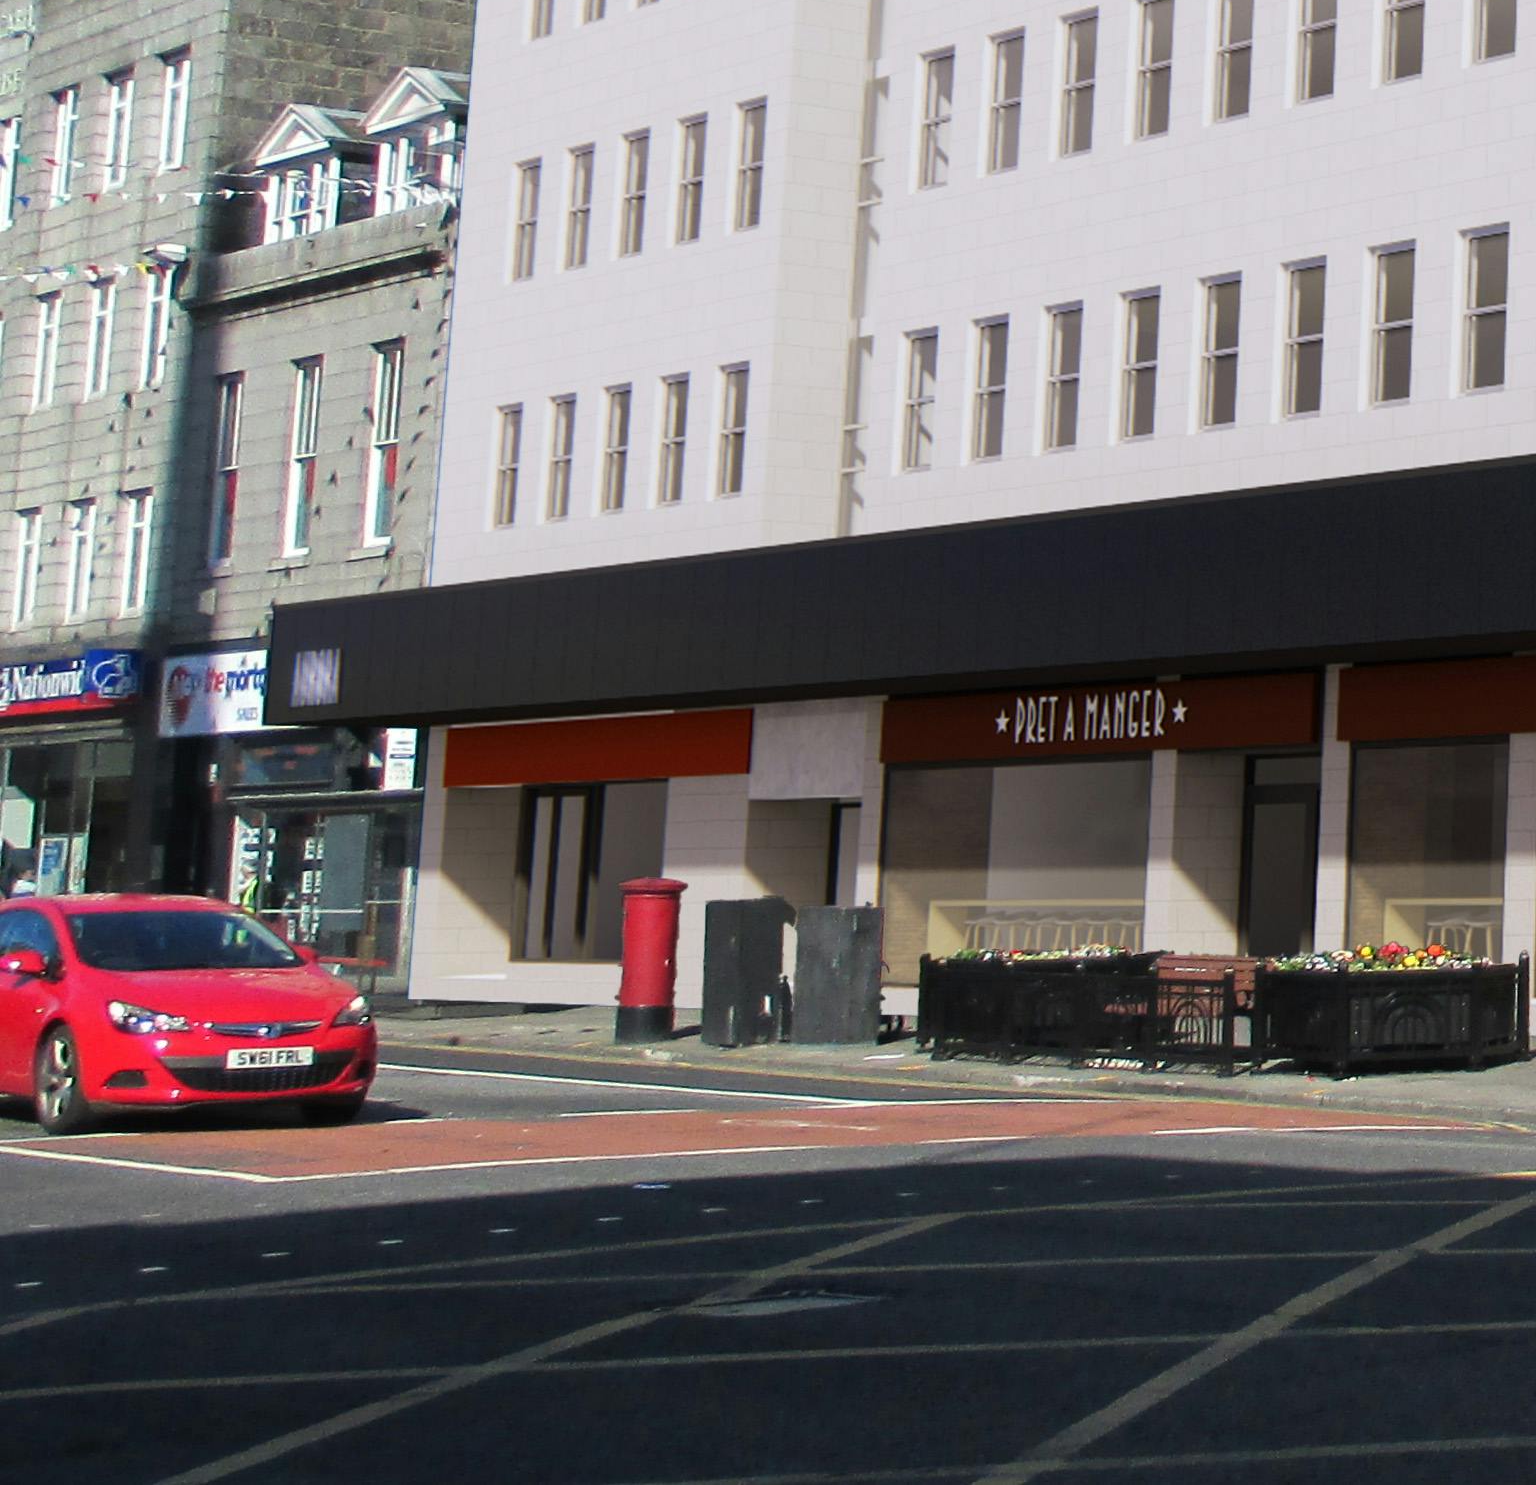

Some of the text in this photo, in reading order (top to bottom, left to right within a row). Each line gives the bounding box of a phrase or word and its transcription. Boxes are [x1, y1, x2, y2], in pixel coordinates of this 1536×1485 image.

[10, 660, 85, 702] Nationwid
[1014, 688, 1166, 744] PRET A MANGER
[276, 1050, 304, 1063] FRL
